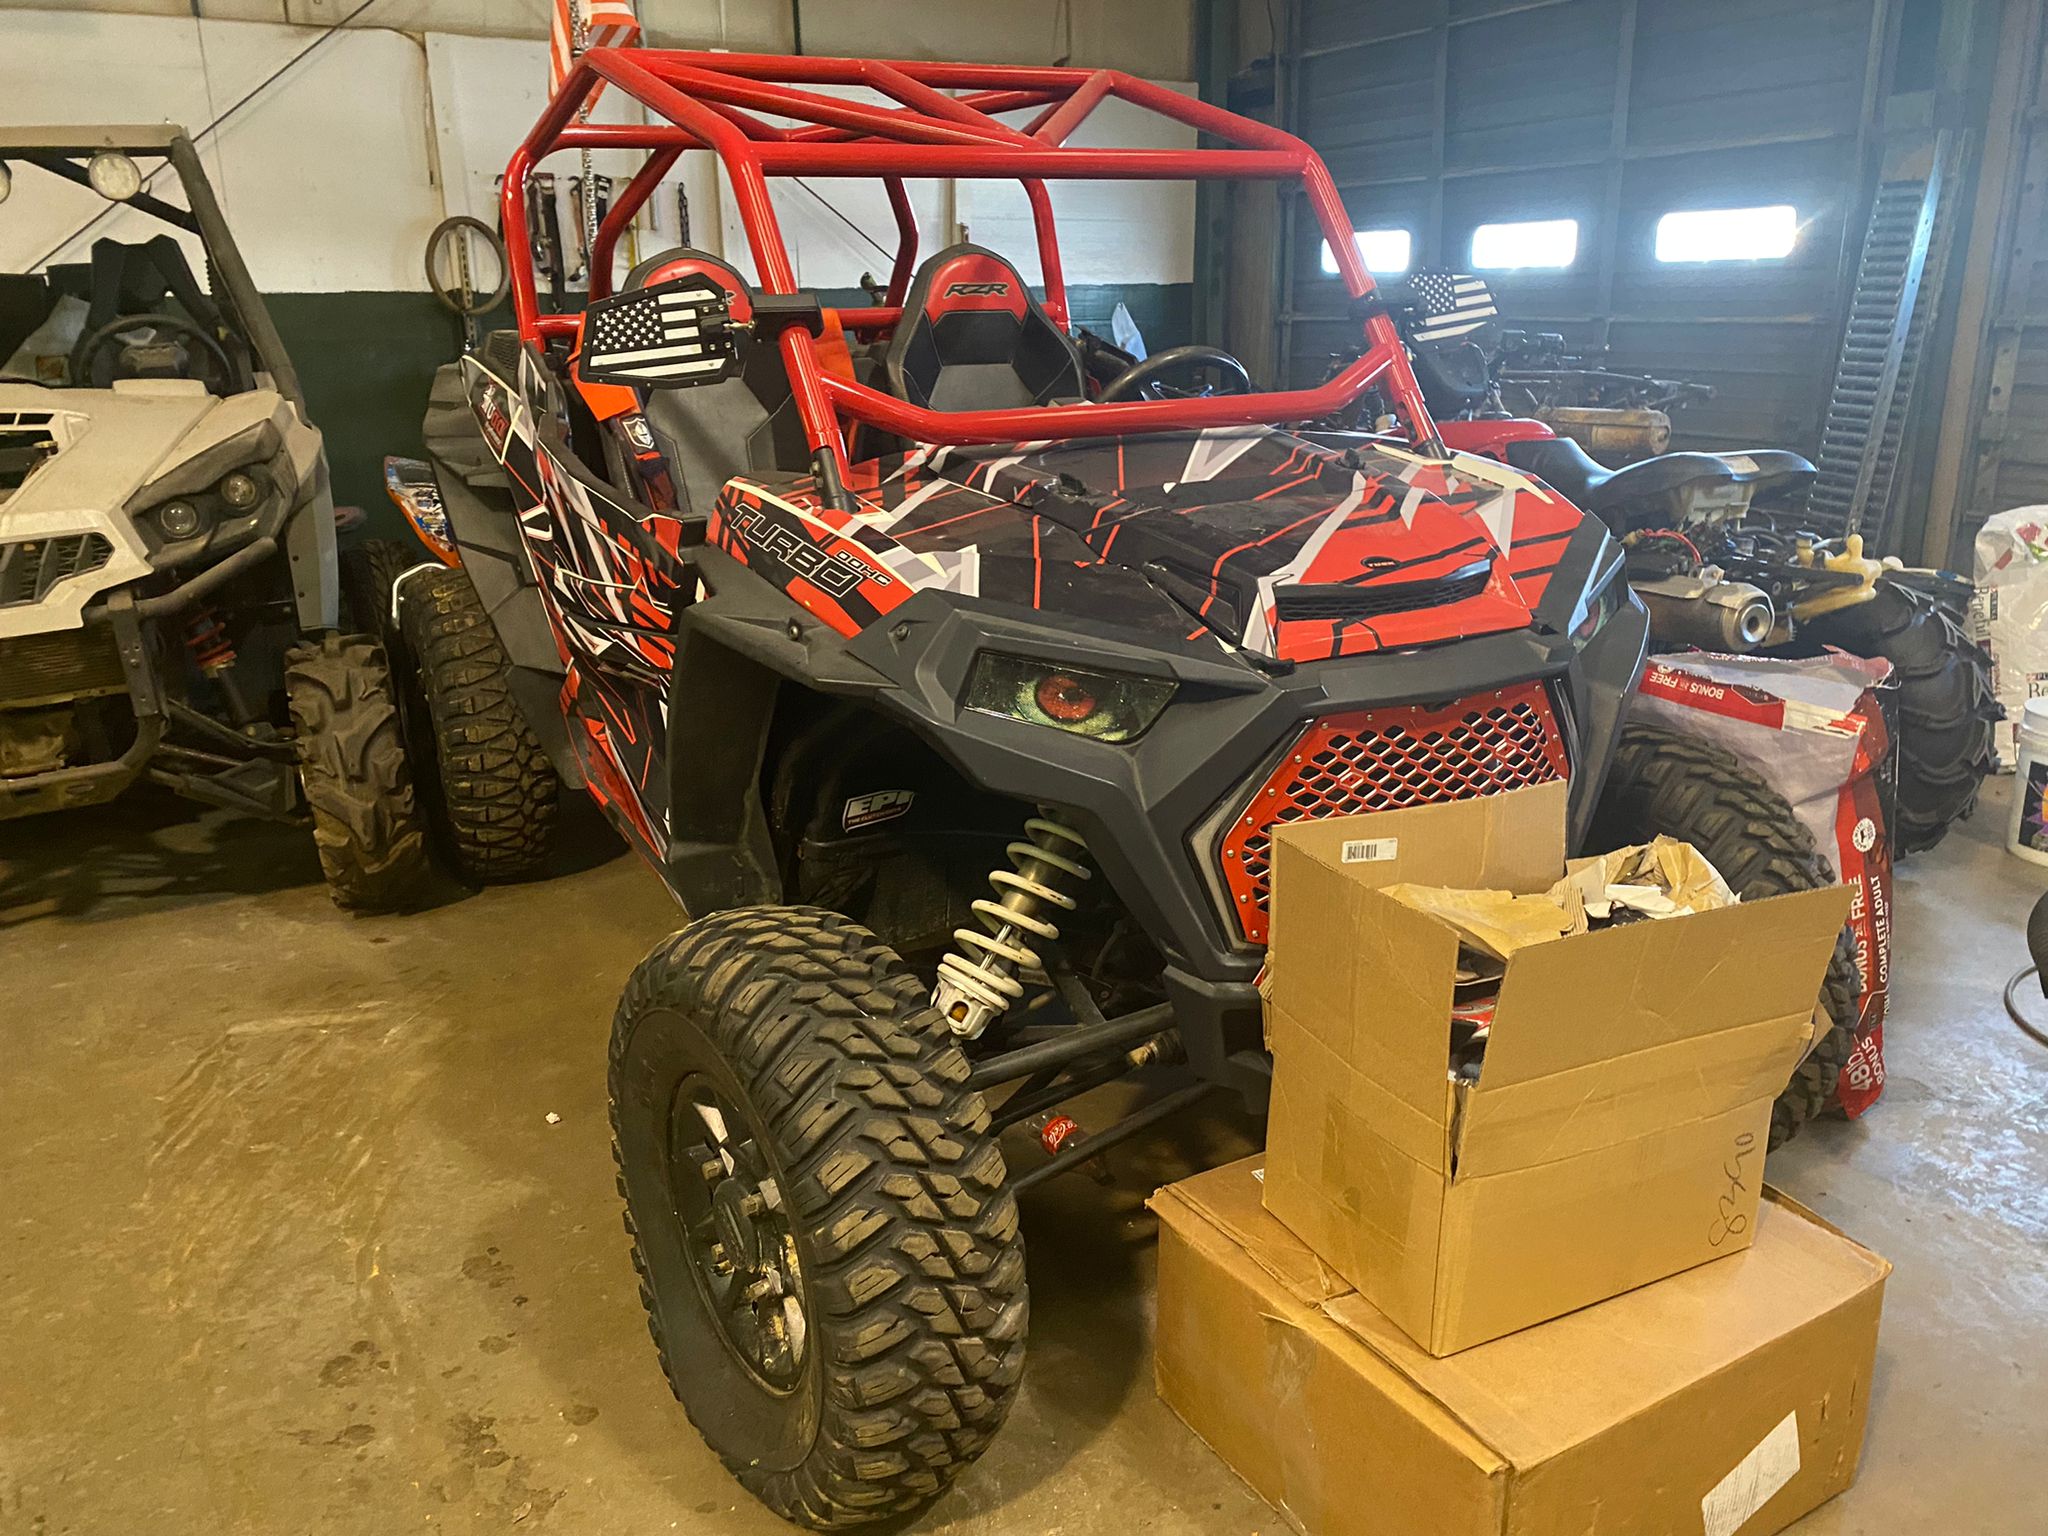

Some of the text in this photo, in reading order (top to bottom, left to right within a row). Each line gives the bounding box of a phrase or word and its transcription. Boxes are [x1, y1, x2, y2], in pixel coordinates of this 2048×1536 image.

[943, 282, 1009, 299] RZR
[730, 502, 864, 598] TURBO
[834, 549, 893, 586] DOHC
[1649, 671, 1679, 689] FREE
[1689, 683, 1725, 700] BONUS
[847, 791, 913, 818] EPI
[1870, 875, 1884, 918] ADULT
[1876, 918, 1888, 983] COMPLETE
[1861, 1036, 1885, 1085] BONUS
